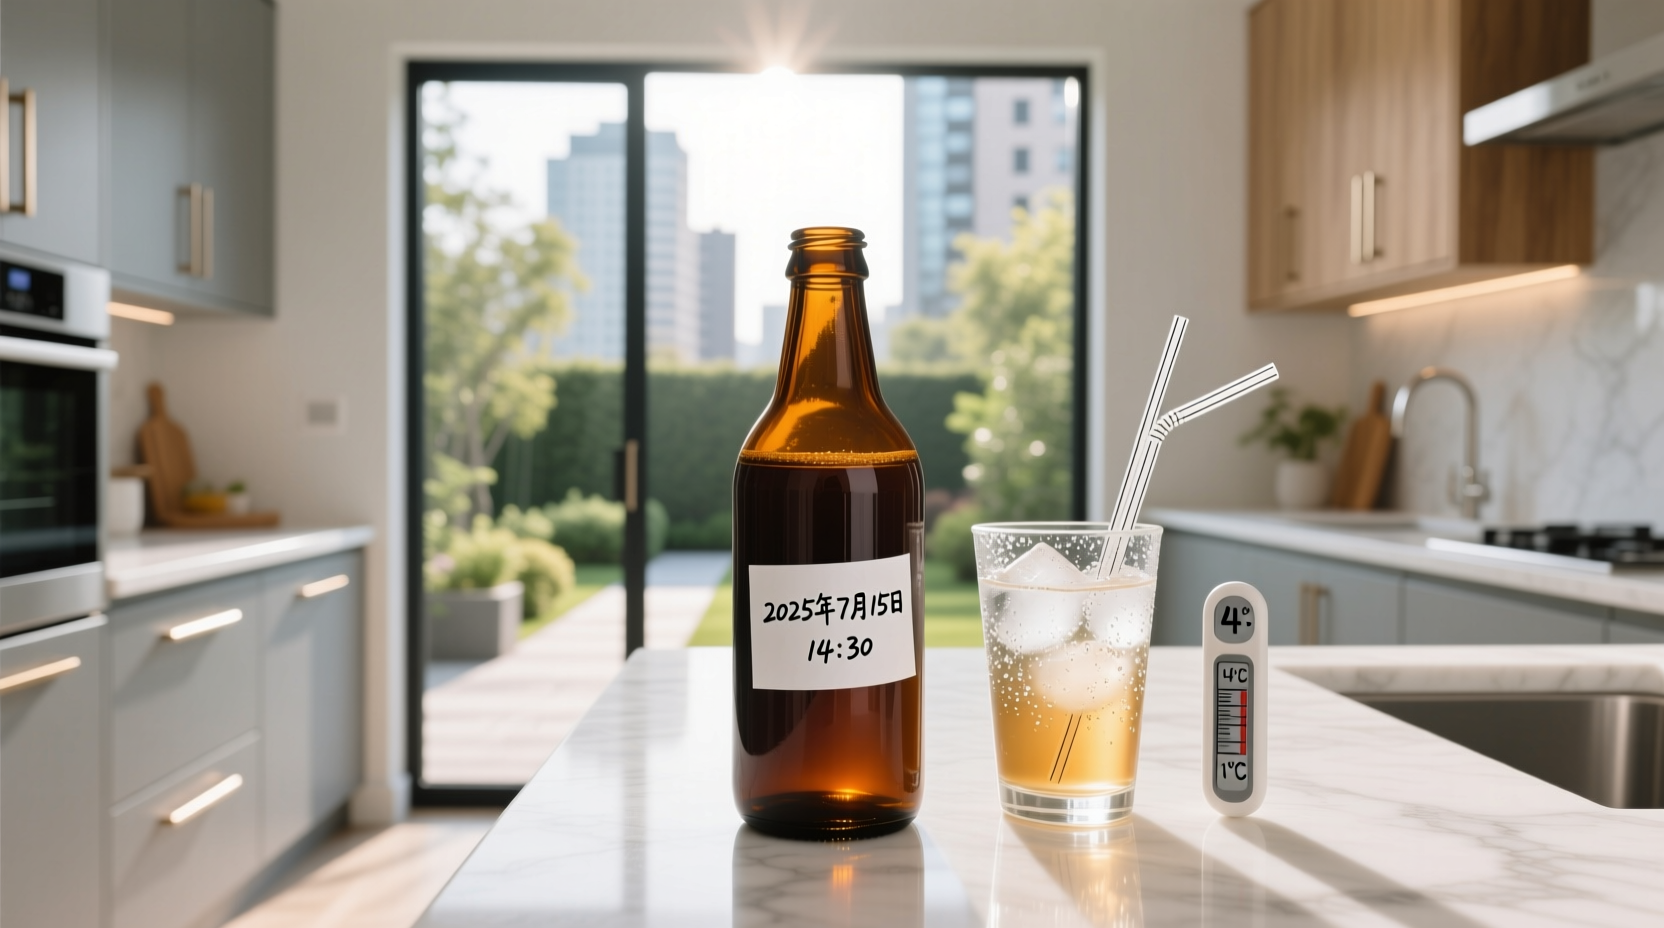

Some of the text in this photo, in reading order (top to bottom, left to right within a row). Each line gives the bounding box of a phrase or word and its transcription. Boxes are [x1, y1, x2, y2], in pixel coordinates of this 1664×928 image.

[763, 589, 903, 626] 2025年7月15日
[807, 635, 873, 664] 14:30
